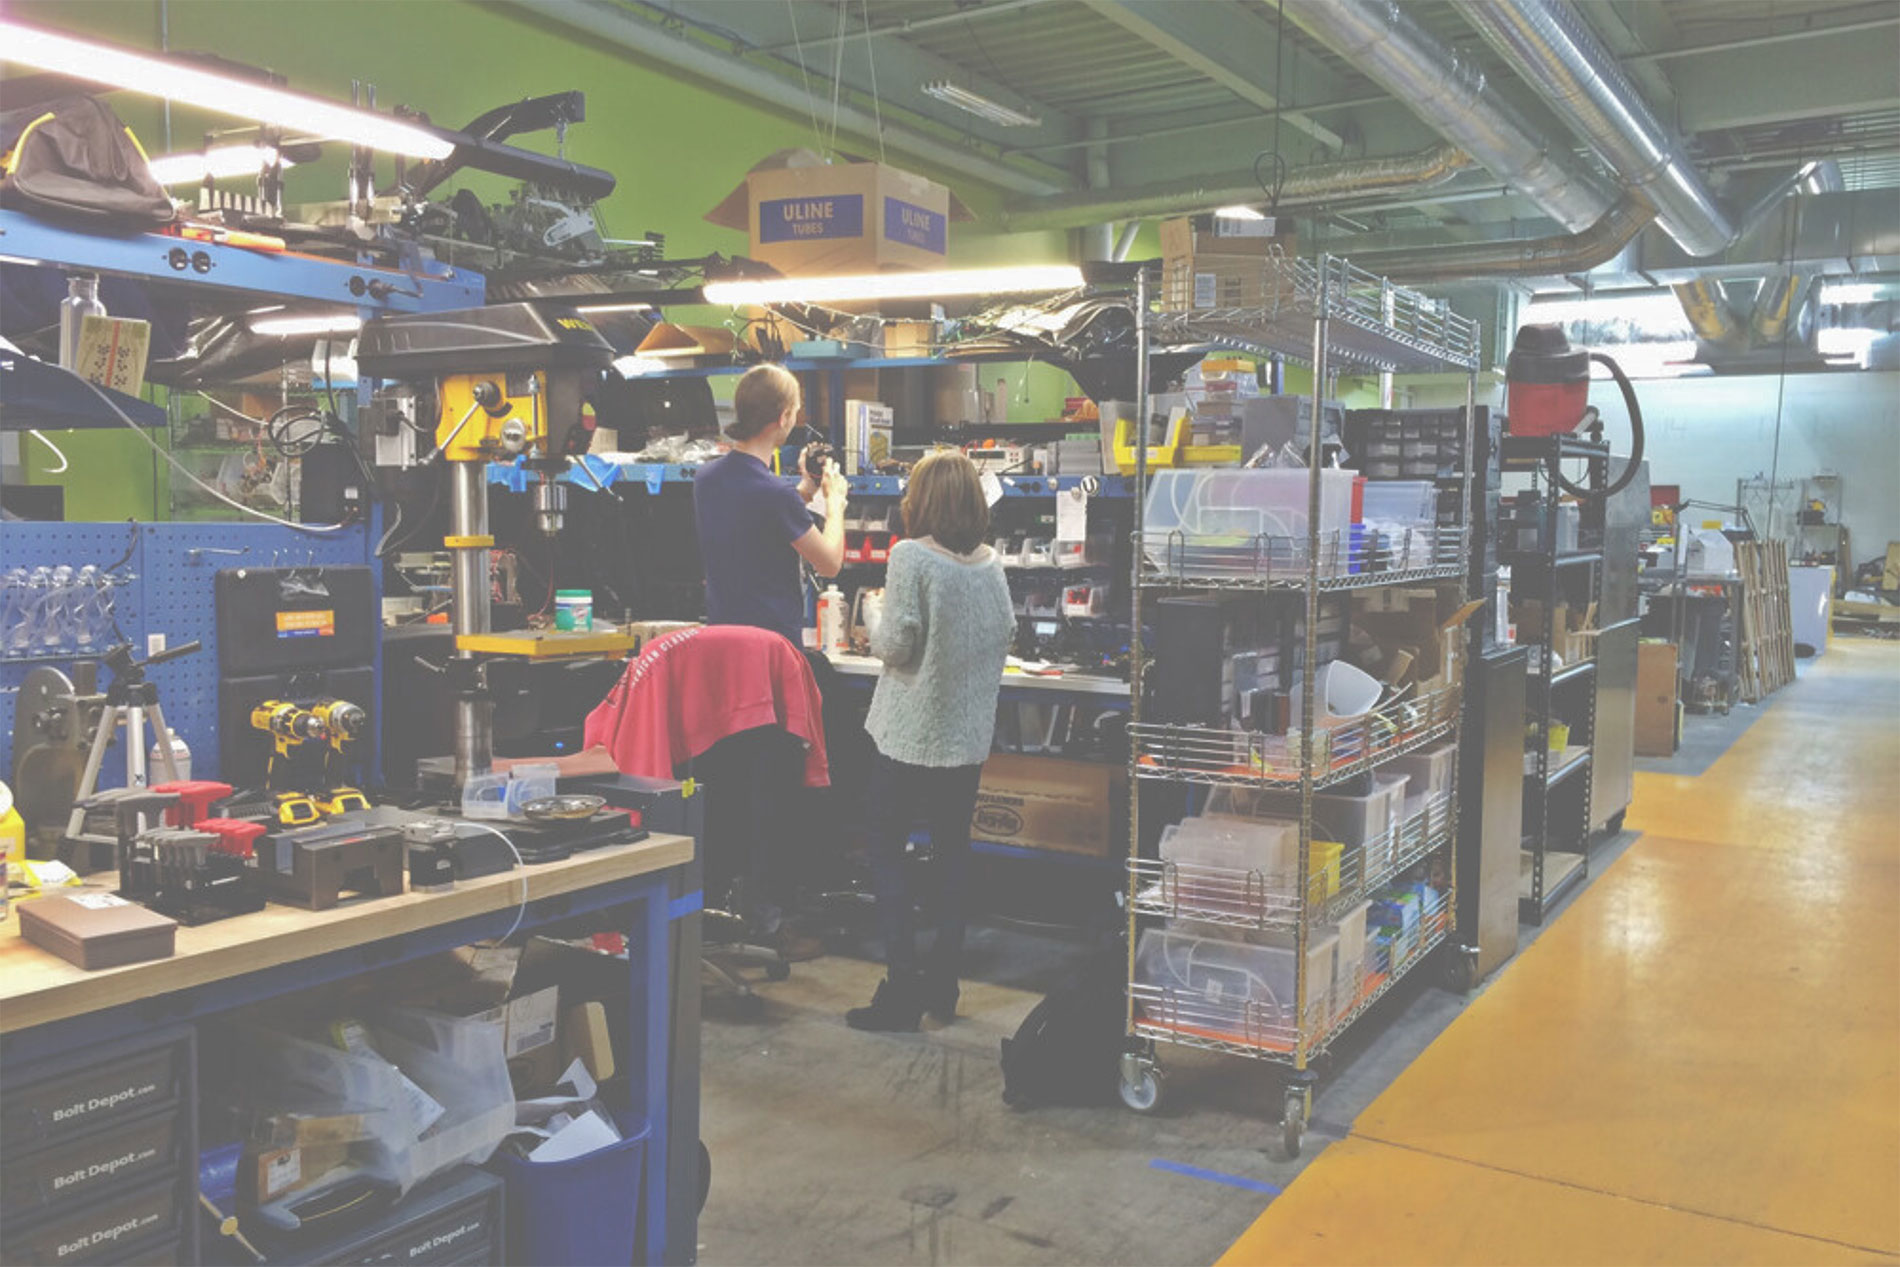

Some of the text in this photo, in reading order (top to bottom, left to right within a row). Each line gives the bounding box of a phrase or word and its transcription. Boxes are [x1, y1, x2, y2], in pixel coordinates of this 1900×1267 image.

[783, 202, 834, 221] ULINE
[901, 207, 931, 232] ULINE
[792, 222, 825, 235] TUBES
[53, 1103, 86, 1121] Bolt
[54, 1170, 87, 1190] Bolt
[58, 1237, 90, 1257] Bolt
[409, 1241, 432, 1258] Bolt
